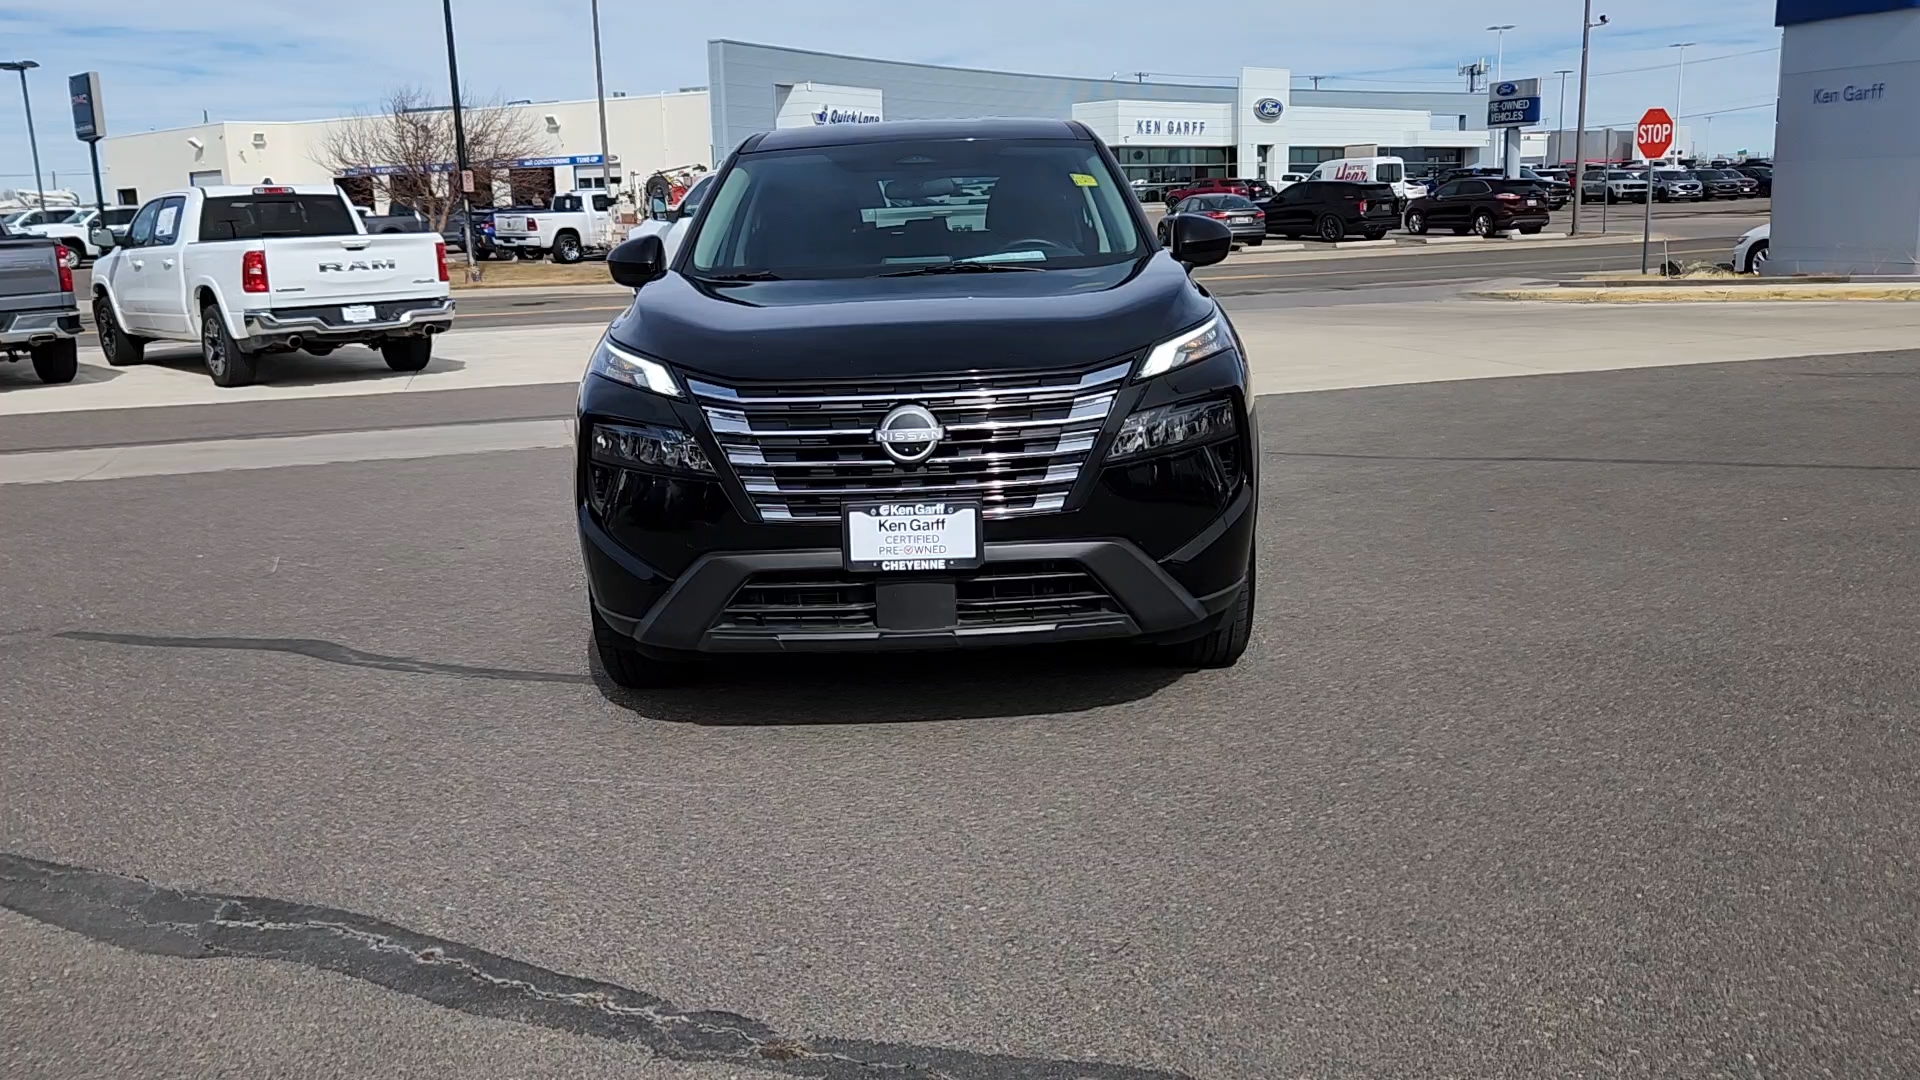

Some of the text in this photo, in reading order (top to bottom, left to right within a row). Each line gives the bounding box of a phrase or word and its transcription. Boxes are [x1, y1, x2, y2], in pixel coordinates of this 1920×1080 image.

[1813, 83, 1886, 104] Ken Garff
[1490, 100, 1530, 111] PRE-OWNED
[829, 109, 880, 124] Quick Lane
[1491, 111, 1524, 122] VEHICLES
[1136, 120, 1206, 135] KEN GARFF
[1638, 123, 1671, 144] STOP
[576, 156, 599, 164] TUNE-UP
[318, 259, 396, 273] RAM
[877, 430, 942, 441] NISSAN
[890, 503, 945, 515] Ken Garff
[878, 518, 946, 532] Ken Garff
[885, 535, 940, 544] CERTIFIED
[878, 545, 947, 555] PRE-OWNED
[882, 560, 946, 570] CHEYENNE
